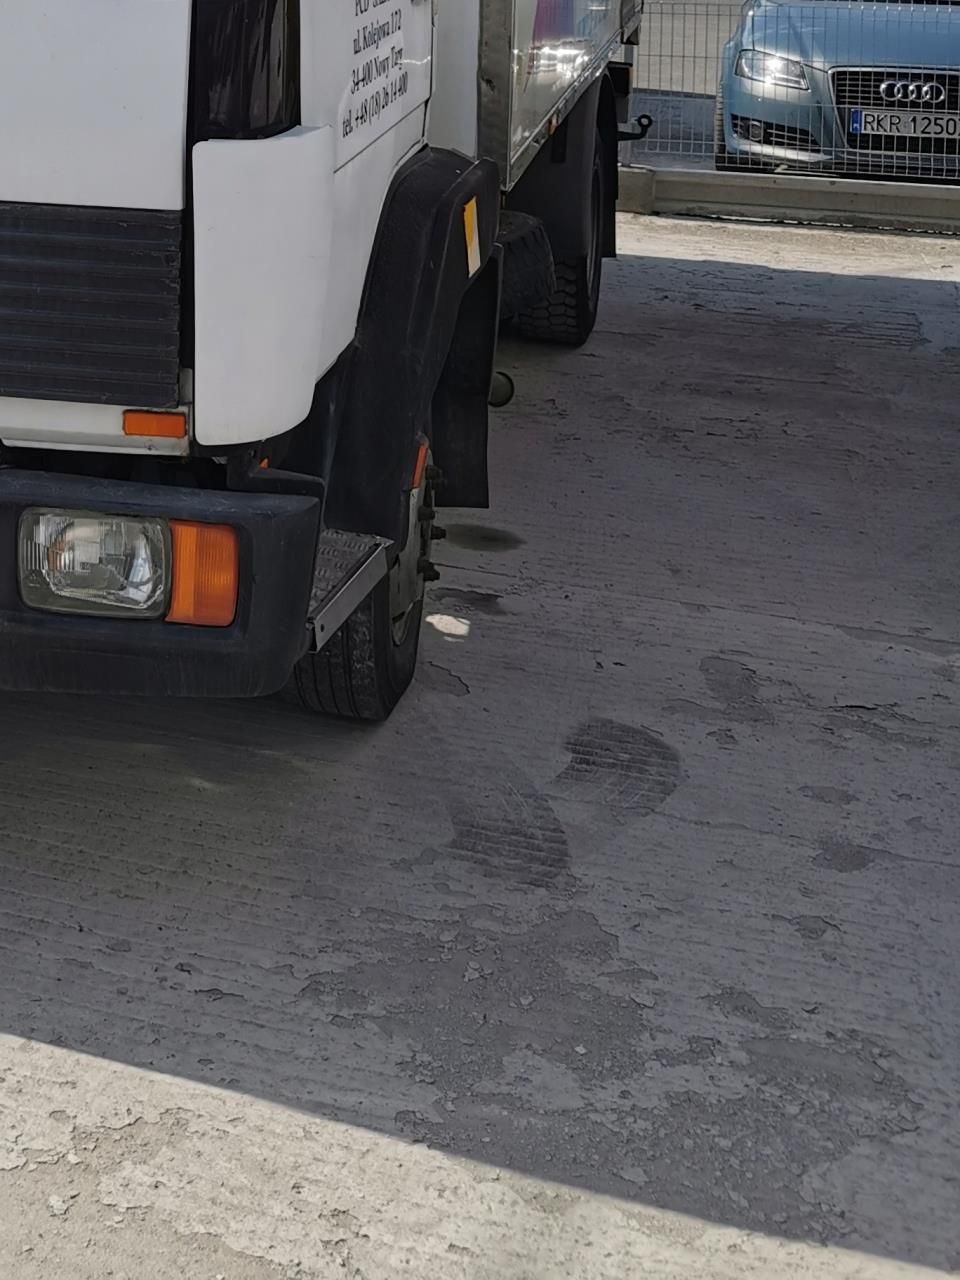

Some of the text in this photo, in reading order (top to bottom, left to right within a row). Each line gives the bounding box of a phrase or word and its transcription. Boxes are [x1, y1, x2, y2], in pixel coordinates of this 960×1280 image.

[362, 18, 390, 50] Kolejowa
[350, 59, 374, 95] 34-400
[373, 56, 390, 80] Nowy
[342, 109, 354, 138] tel.
[863, 113, 960, 136] RKR 1250
